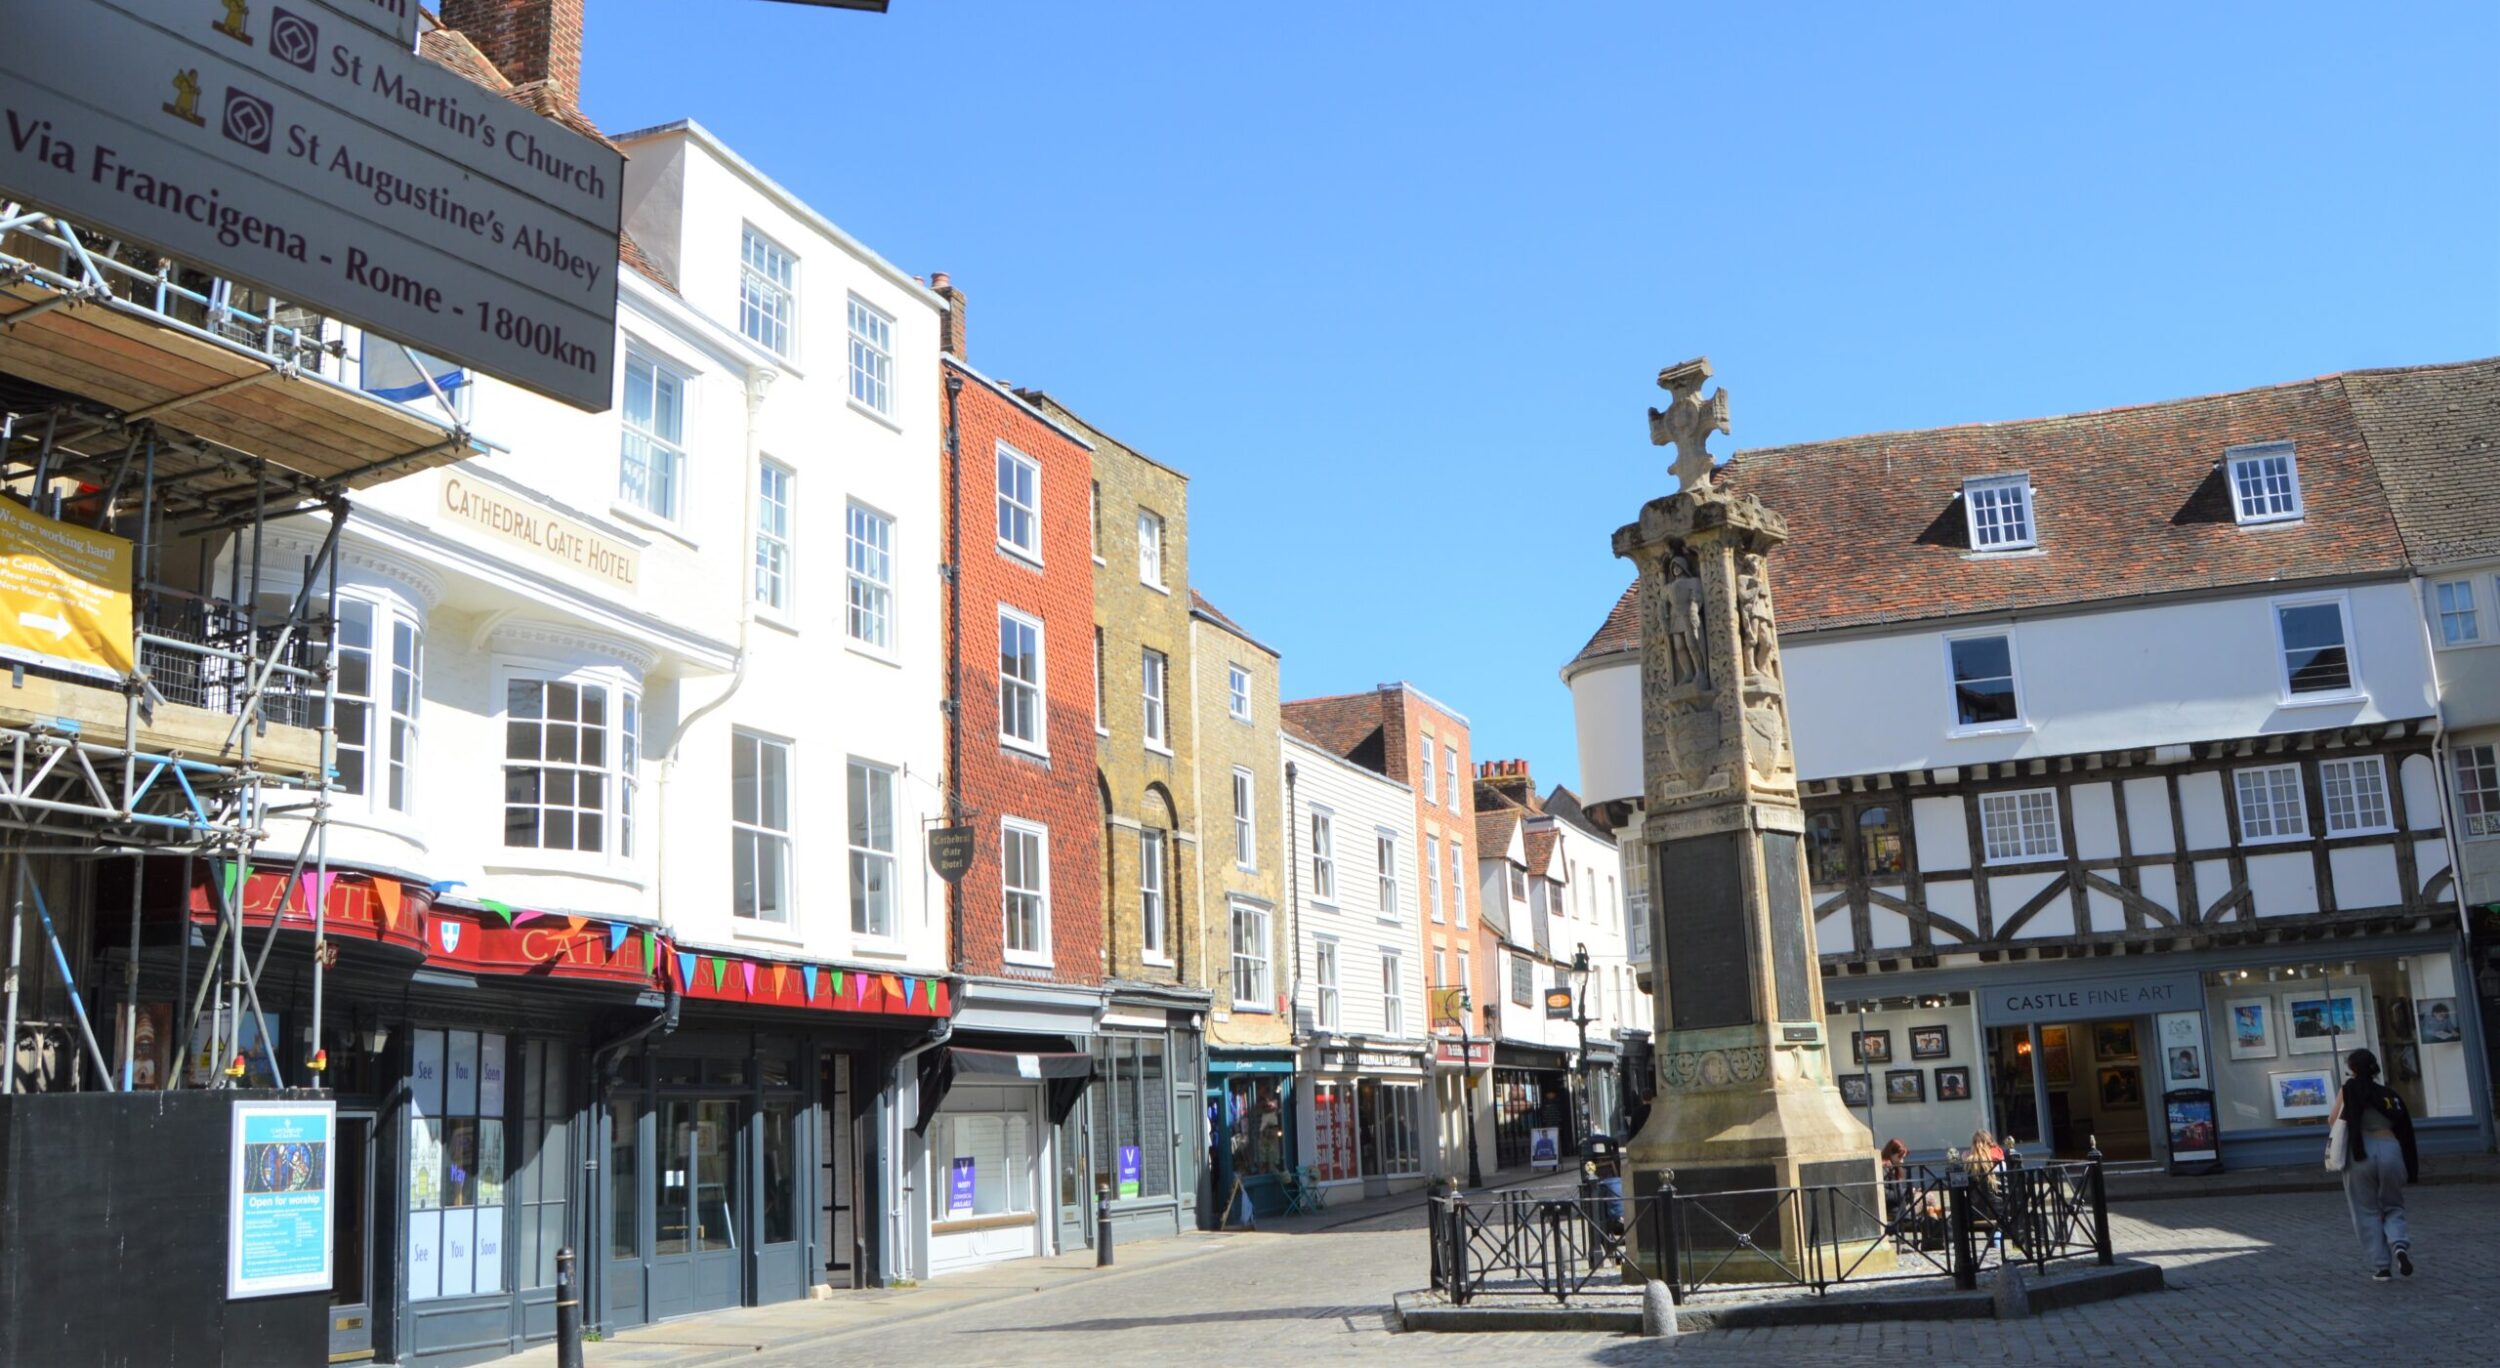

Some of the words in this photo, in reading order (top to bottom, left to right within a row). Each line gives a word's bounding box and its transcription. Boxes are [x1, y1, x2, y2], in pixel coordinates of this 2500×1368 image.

[331, 44, 362, 86] St
[372, 64, 496, 148] Martin's
[505, 130, 606, 199] Church
[287, 124, 320, 166] St
[329, 145, 505, 244] Augustine's
[513, 225, 601, 292] Abbey
[6, 109, 76, 174] Via
[92, 145, 308, 263] Francigena
[345, 247, 442, 314] Rome
[476, 301, 597, 375] 1800km
[445, 478, 542, 547] CATHEDRAL
[545, 521, 583, 564] GATE
[587, 538, 633, 584] HOTEL
[2006, 992, 2079, 1012] CASTLE
[2088, 987, 2129, 1005] FINE
[2138, 984, 2175, 1001] ART
[418, 1061, 433, 1079] See
[455, 1062, 468, 1080] You
[484, 1063, 500, 1081] Soon
[451, 1163, 466, 1183] May
[249, 1196, 273, 1208] Open
[275, 1195, 286, 1206] for
[288, 1193, 320, 1207] worship
[415, 1243, 428, 1262] See
[451, 1240, 464, 1258] You
[481, 1238, 496, 1256] Soon
